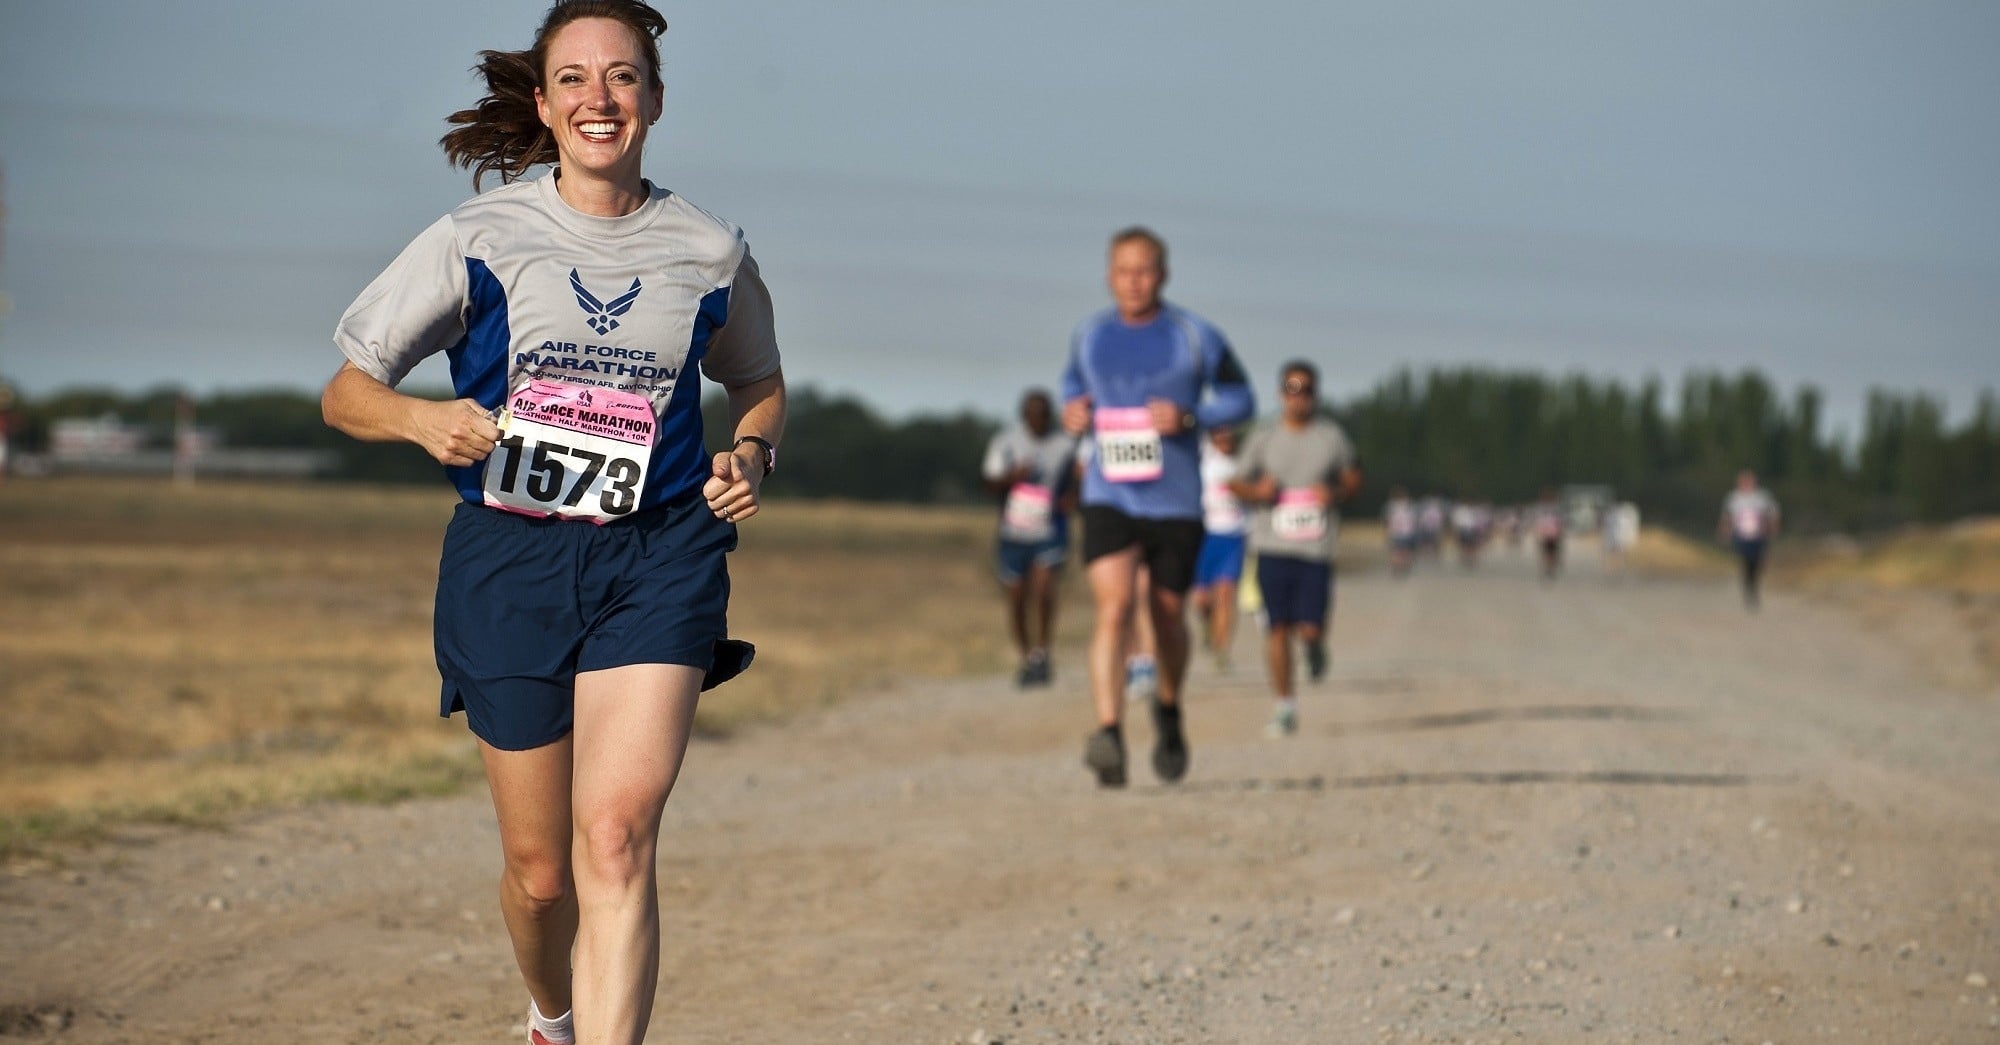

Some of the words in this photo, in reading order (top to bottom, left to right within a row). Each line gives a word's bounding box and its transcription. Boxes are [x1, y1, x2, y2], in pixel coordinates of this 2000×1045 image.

[541, 341, 577, 353] AIR
[584, 345, 656, 362] FORCE
[516, 352, 677, 380] MARATHON
[514, 397, 537, 411] AIR
[540, 404, 575, 418] ORCE
[577, 409, 652, 434] MARATHON
[558, 417, 579, 427] HALF
[580, 422, 625, 438] MARATHON
[631, 433, 646, 441] 10K
[499, 435, 641, 515] 1573
